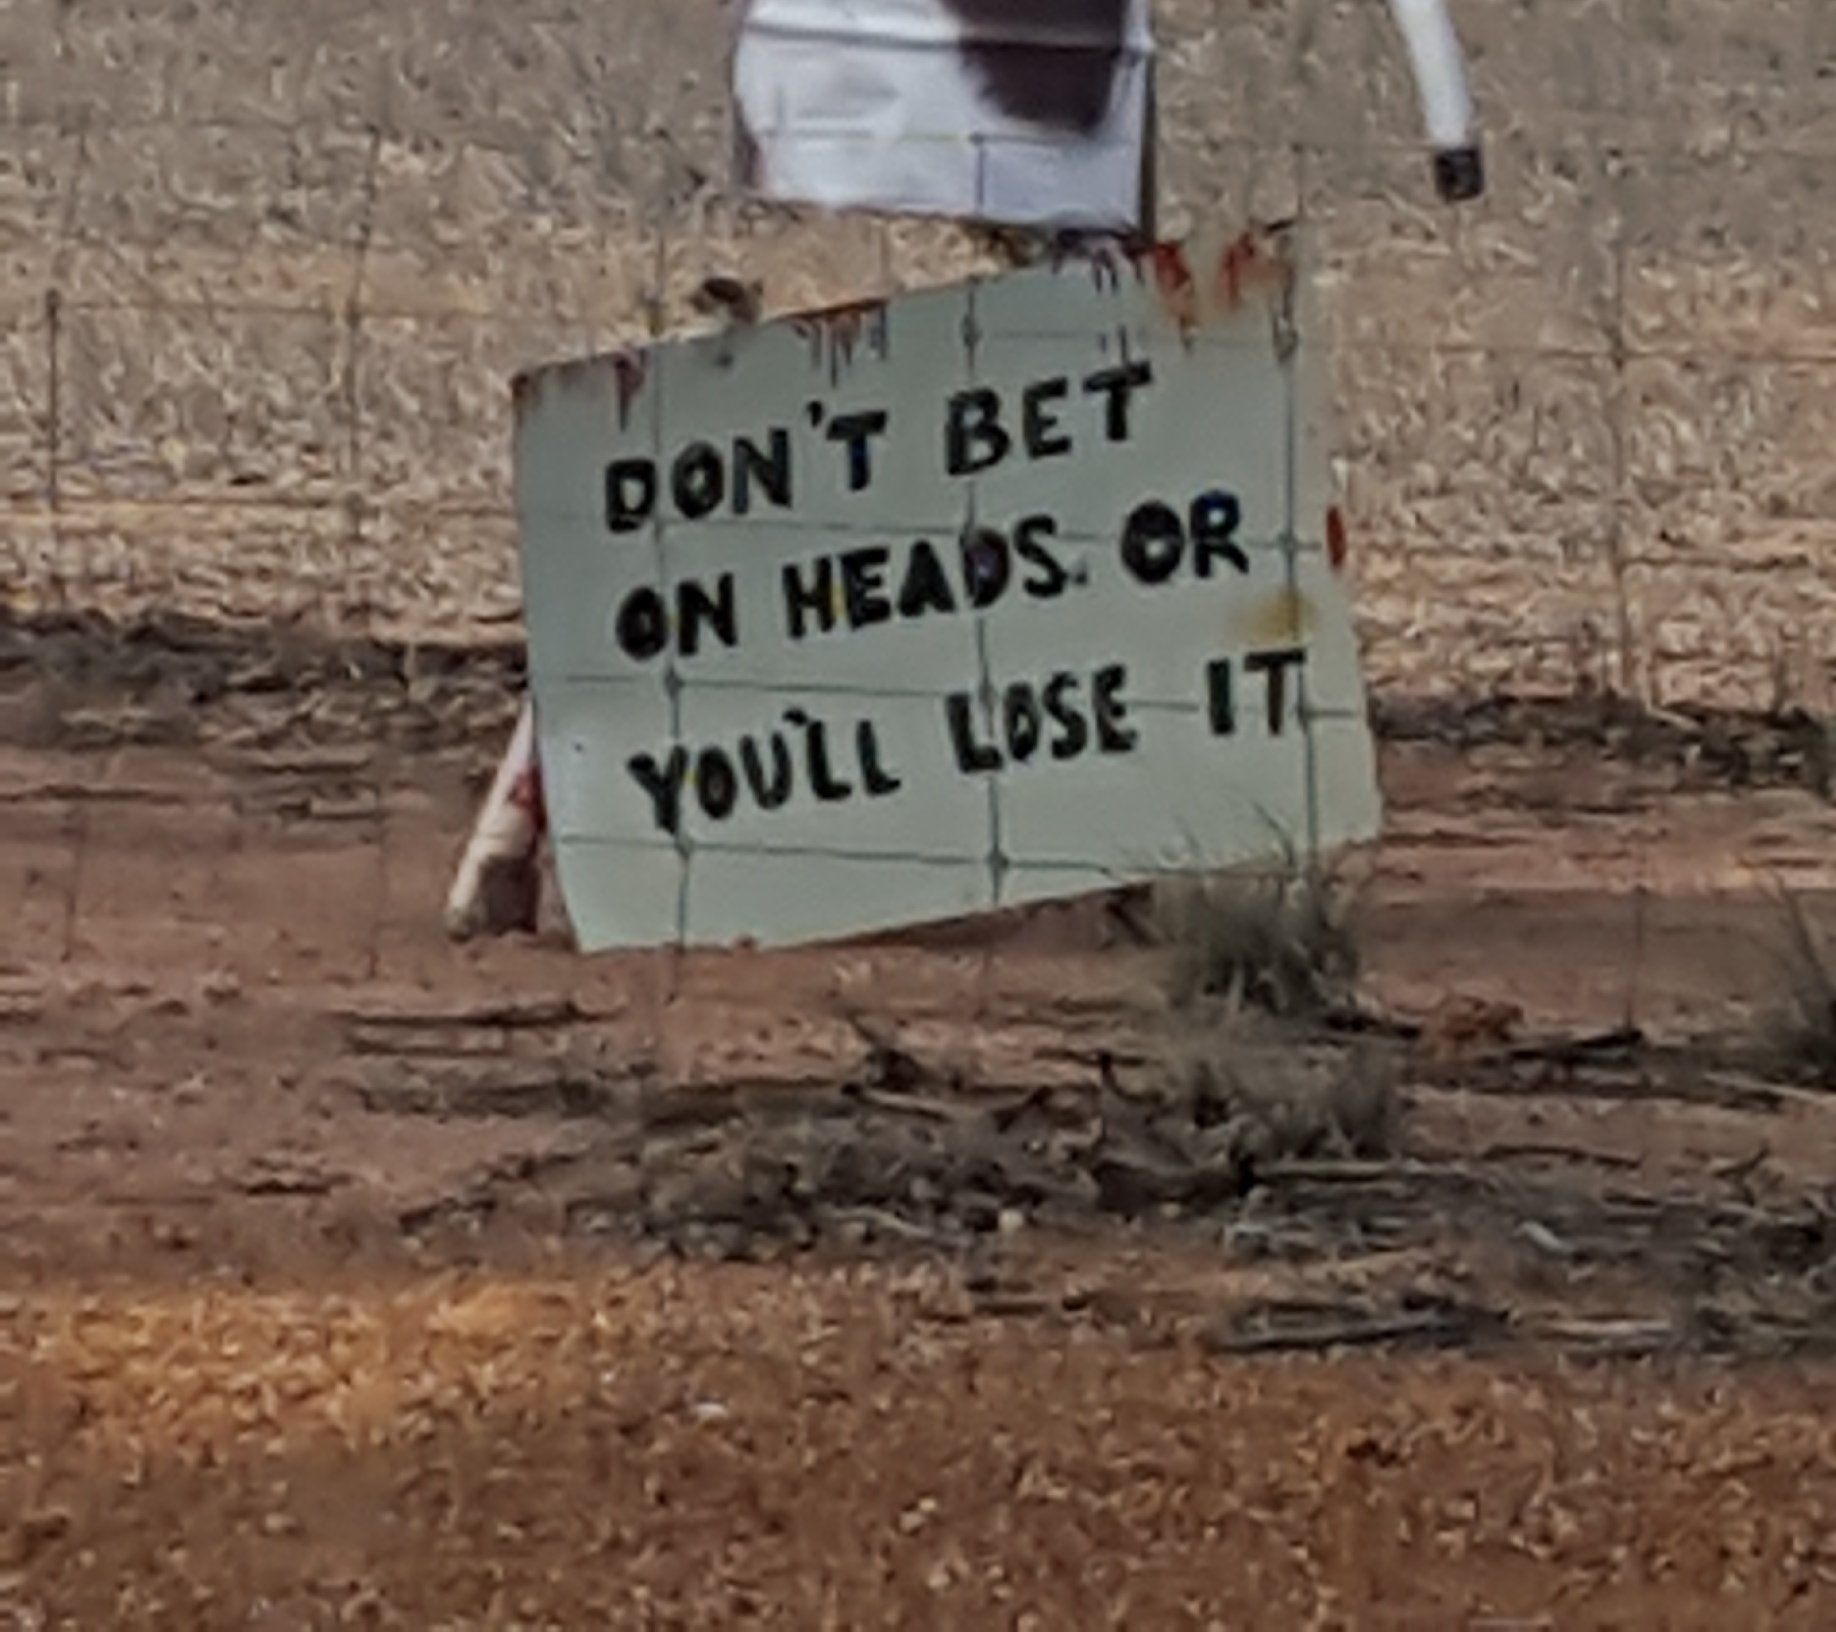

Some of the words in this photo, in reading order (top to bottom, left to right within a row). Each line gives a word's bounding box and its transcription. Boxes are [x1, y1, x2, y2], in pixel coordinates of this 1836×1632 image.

[604, 400, 888, 534] DON'T
[944, 362, 1153, 476] BET
[616, 571, 737, 659] ON
[1120, 489, 1250, 584] OR
[627, 707, 901, 836] YOU'LL
[944, 662, 1139, 774] LOSE
[1205, 647, 1307, 737] IT
